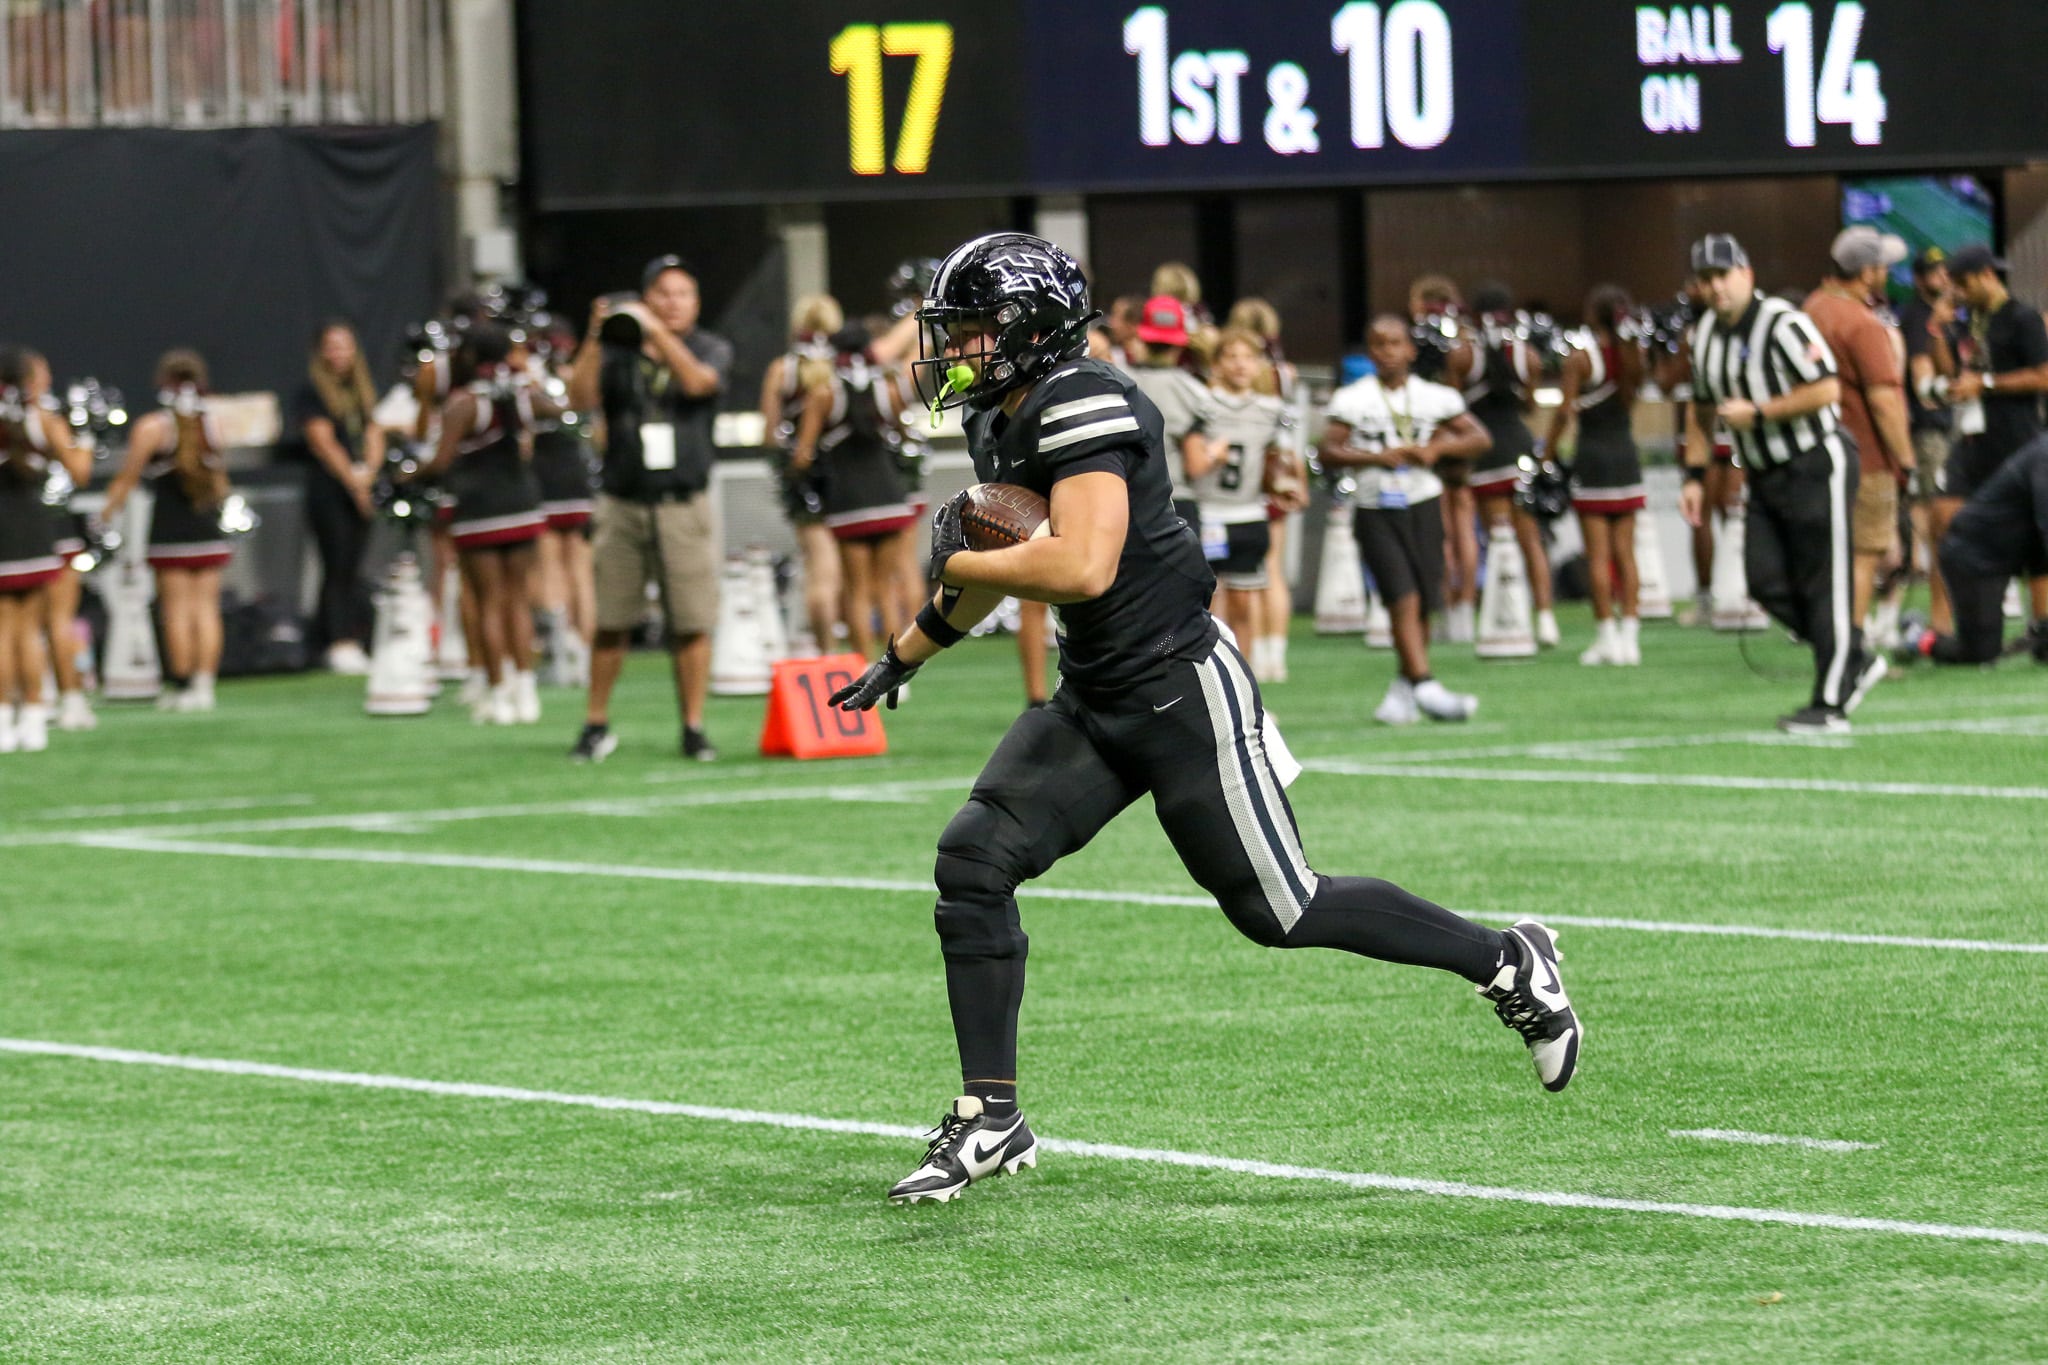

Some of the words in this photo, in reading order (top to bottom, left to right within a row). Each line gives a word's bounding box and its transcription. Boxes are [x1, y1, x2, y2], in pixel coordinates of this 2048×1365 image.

[829, 22, 953, 176] 17
[1123, 5, 1249, 146] 1ST
[1263, 62, 1320, 155] &
[1331, 0, 1454, 149] 10
[1636, 4, 1742, 65] BALL
[1641, 74, 1701, 134] ON
[1766, 1, 1887, 147] 14
